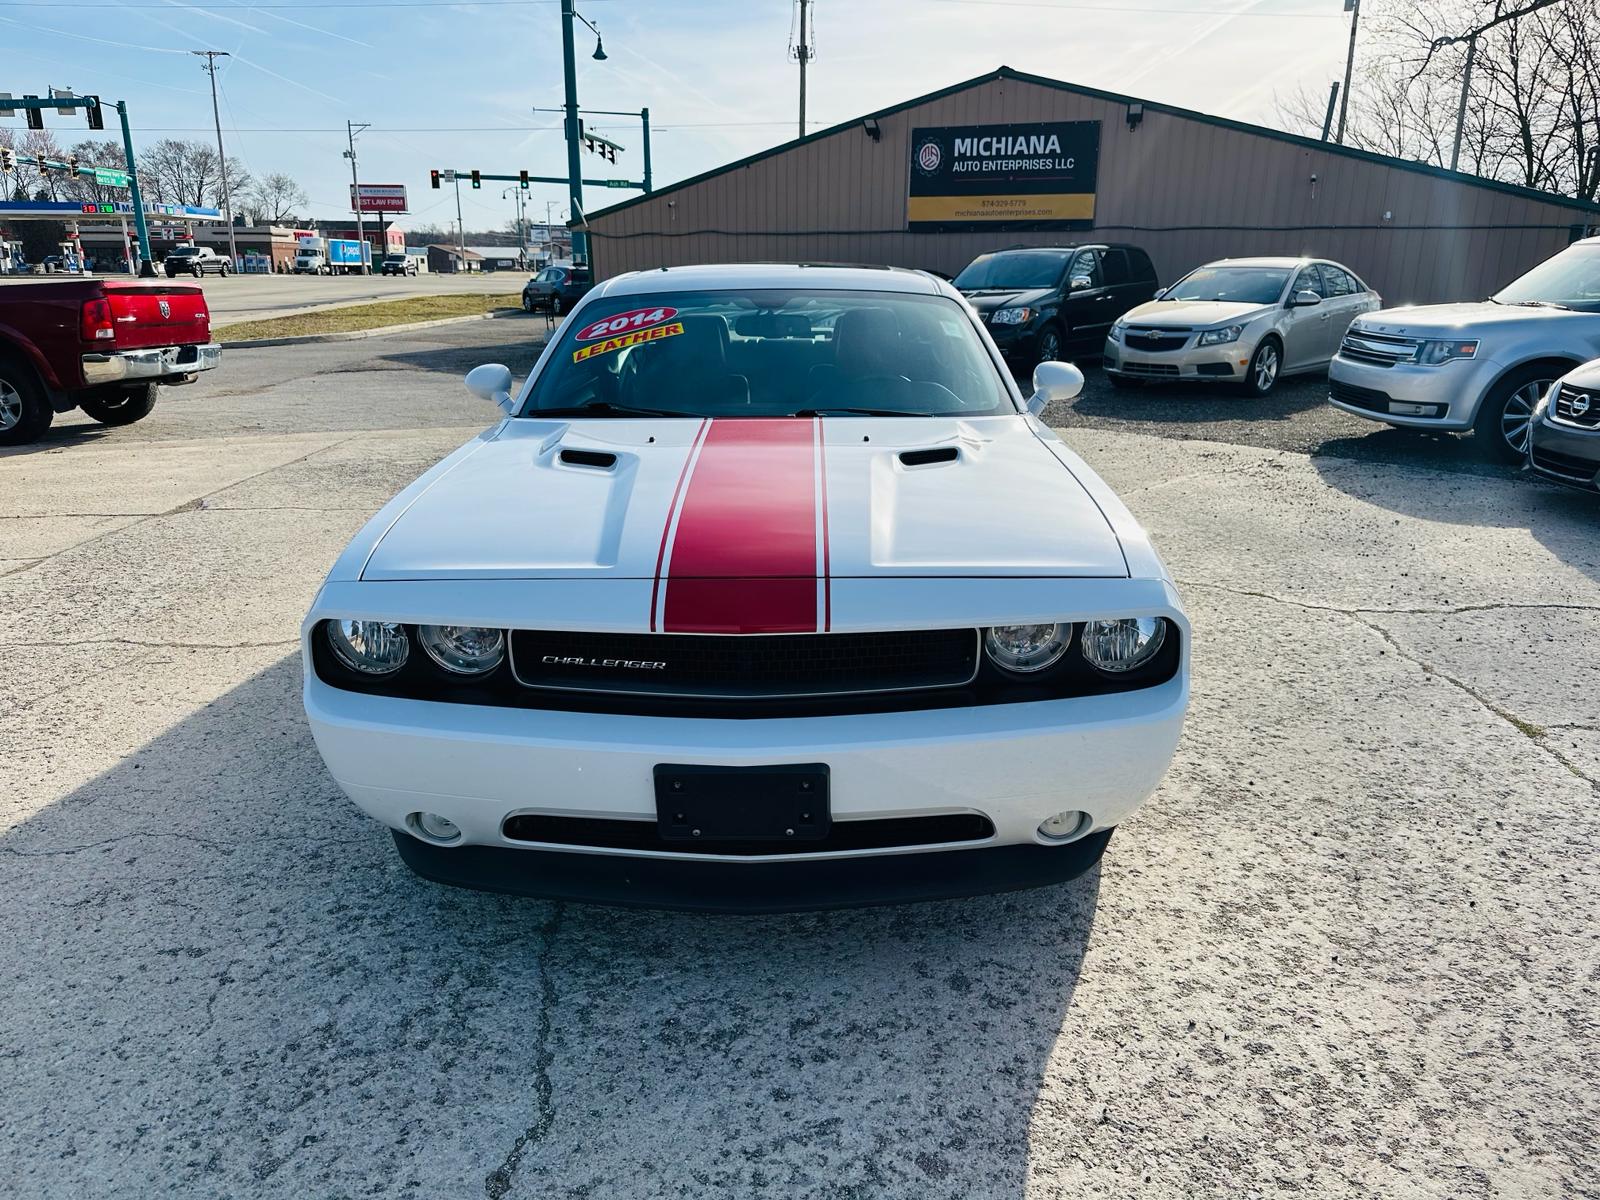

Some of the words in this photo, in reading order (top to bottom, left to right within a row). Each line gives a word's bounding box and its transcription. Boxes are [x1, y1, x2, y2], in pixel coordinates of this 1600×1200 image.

[954, 135, 1061, 157] MICHIANA
[952, 160, 981, 172] AUTO
[982, 159, 1052, 171] ENTERPRISES
[1055, 158, 1075, 169] LLC
[121, 203, 149, 214] Moil
[587, 308, 665, 338] 2014
[575, 325, 681, 361] LEATHER
[541, 655, 666, 669] CHALLENGER
